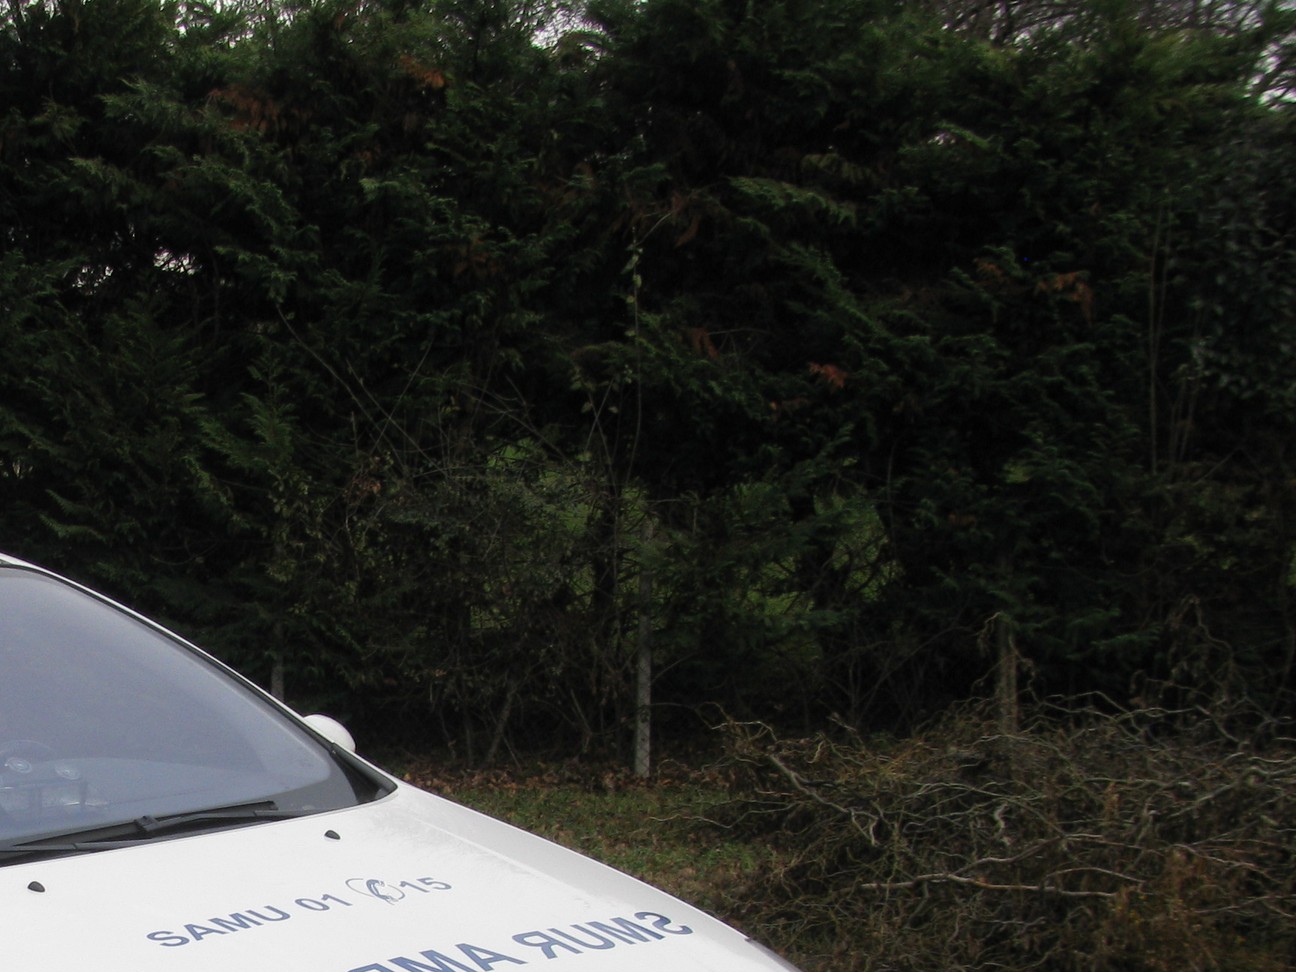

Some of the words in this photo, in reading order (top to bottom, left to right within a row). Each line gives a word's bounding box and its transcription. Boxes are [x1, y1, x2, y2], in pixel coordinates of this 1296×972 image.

[146, 905, 291, 947] SAMU
[294, 893, 353, 911] 01
[399, 876, 453, 893] 15
